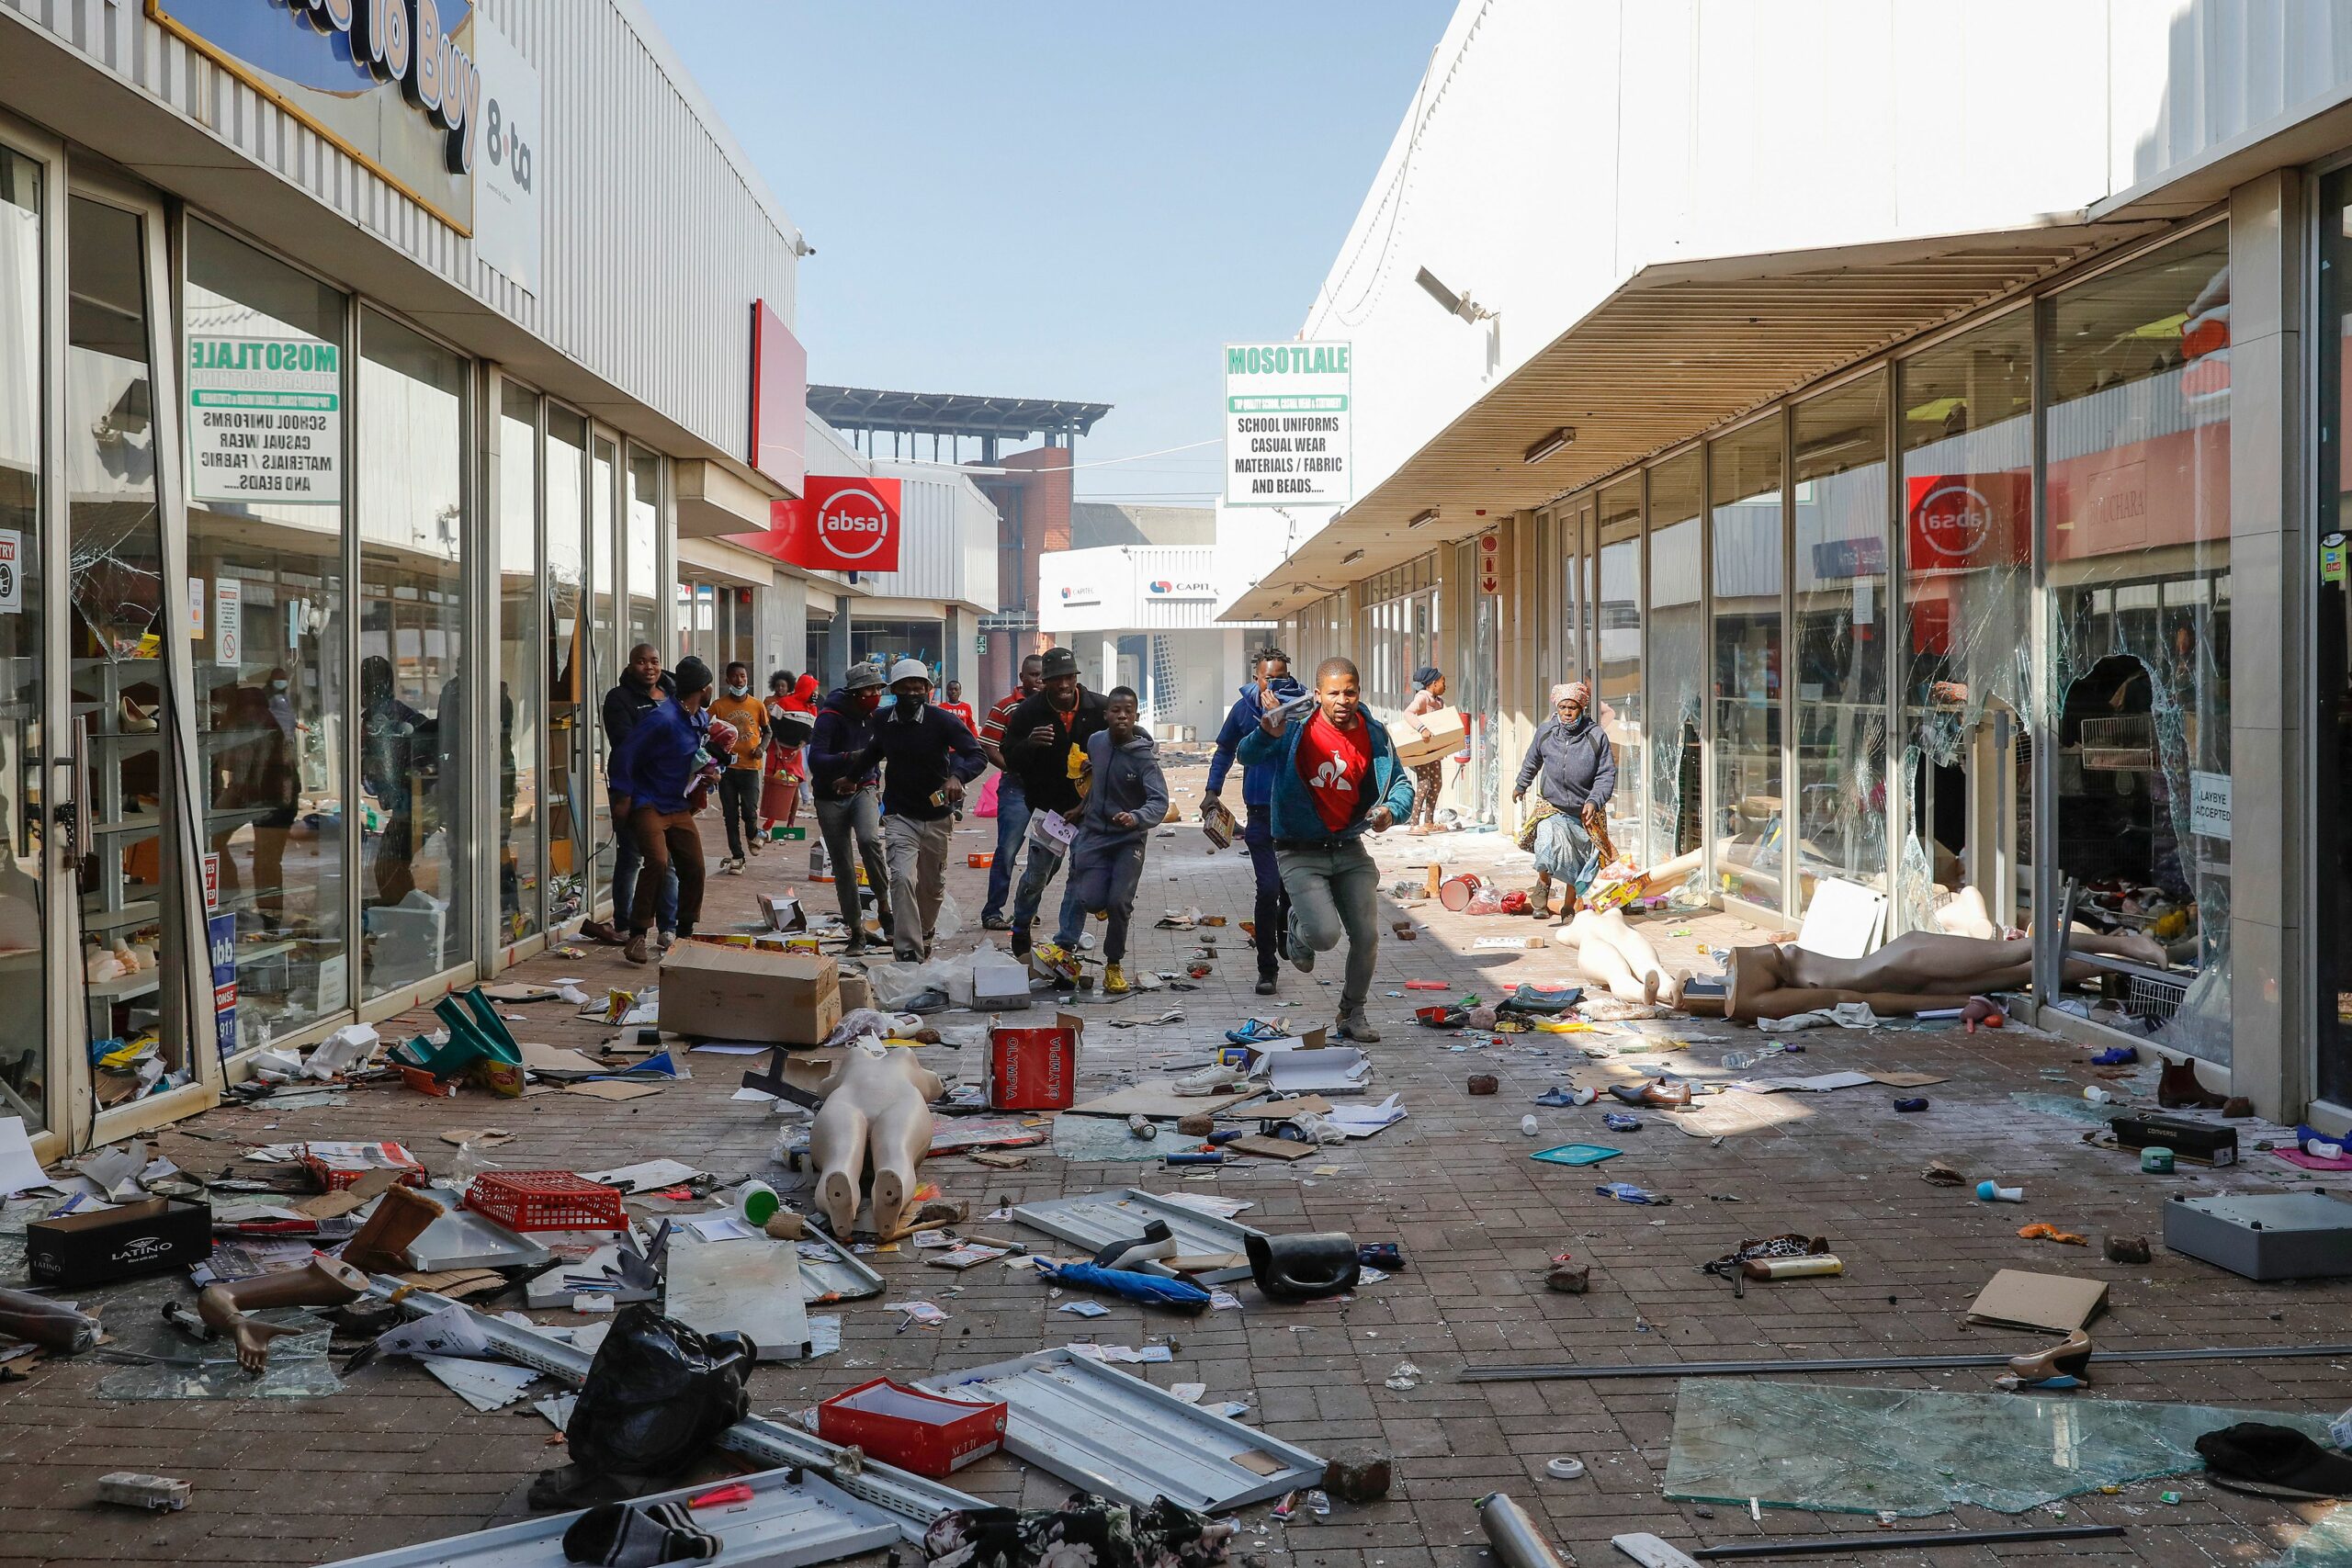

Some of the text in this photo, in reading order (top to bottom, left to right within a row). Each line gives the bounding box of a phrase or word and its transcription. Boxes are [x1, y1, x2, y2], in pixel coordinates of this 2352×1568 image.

[1227, 346, 1349, 375] MOSOTLALE
[1238, 417, 1339, 433] SCHOOL UNIFORMS
[1251, 437, 1326, 453] CASUAL WEAR
[1235, 457, 1342, 473] MATERIALS / FABRIC
[1252, 479, 1274, 494] AND
[827, 510, 879, 532] absa
[2200, 791, 2227, 805] LAYBYE
[2195, 805, 2231, 821] ACCEPTED
[1006, 1036, 1019, 1100] OLYMPIA
[1048, 1036, 1061, 1100] OLYMPIA
[2147, 1127, 2178, 1138] CONVERSE
[112, 1242, 173, 1260] LATINO
